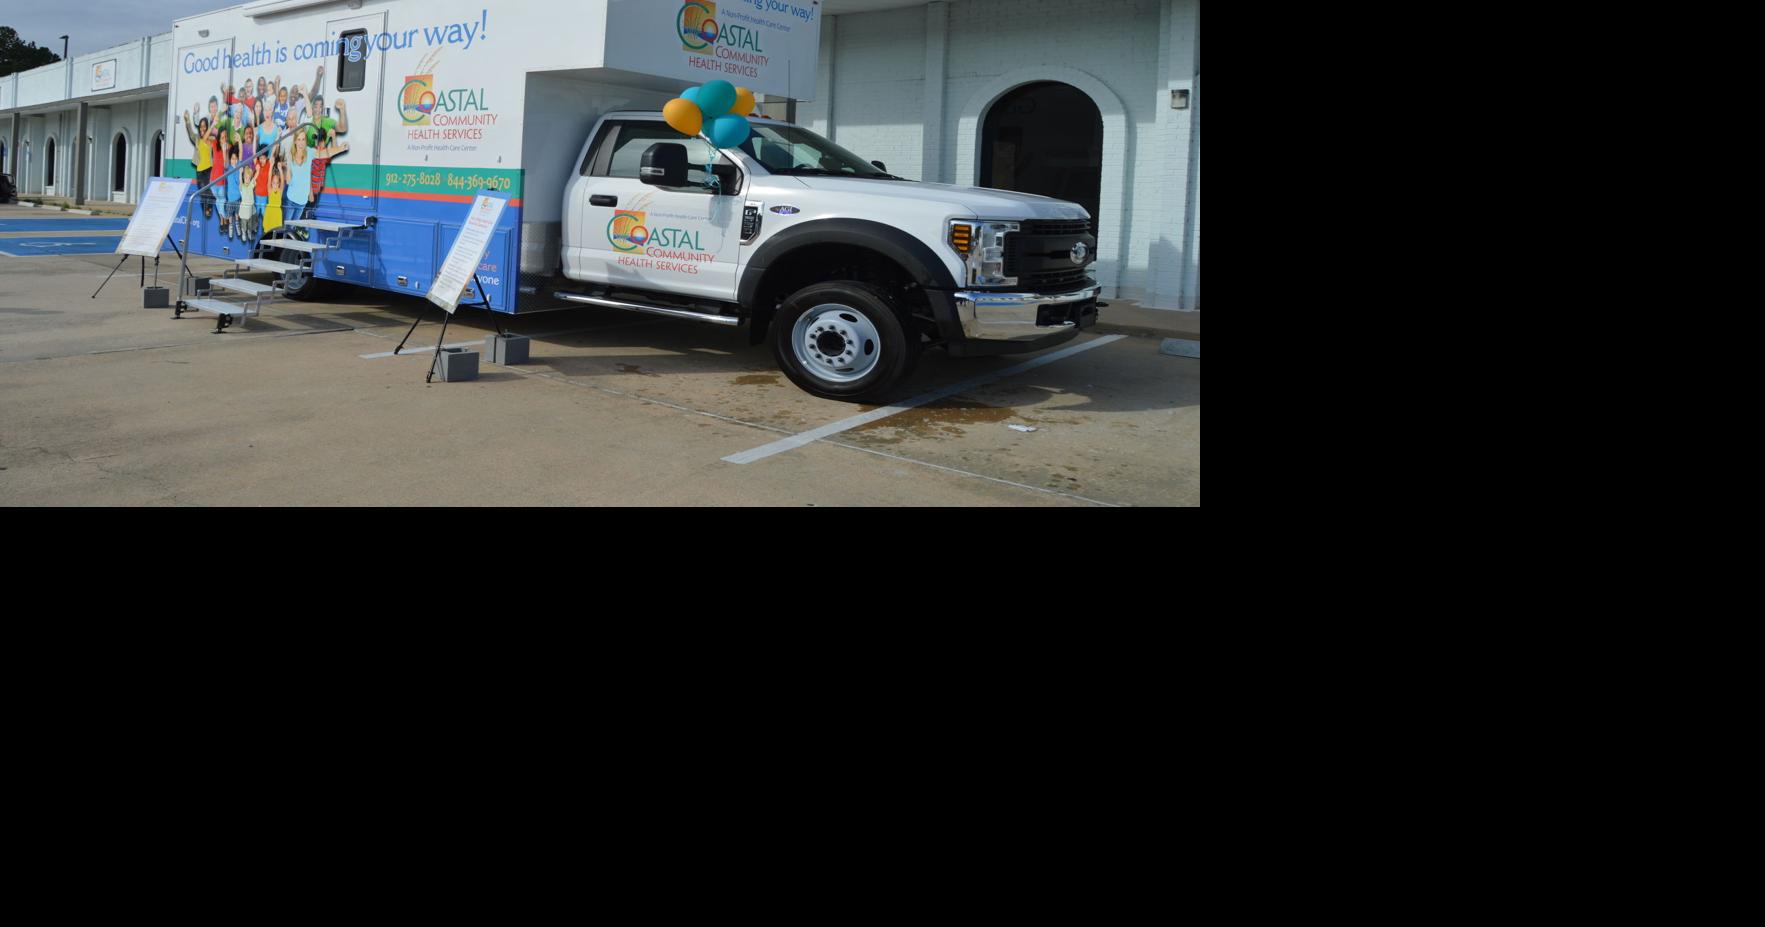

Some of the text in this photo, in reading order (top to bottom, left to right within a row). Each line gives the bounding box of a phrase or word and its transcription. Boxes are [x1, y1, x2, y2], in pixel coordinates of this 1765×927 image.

[766, 0, 788, 13] your
[791, 5, 814, 22] way!
[677, 2, 762, 52] COASTAL
[184, 9, 488, 74] Good health is coming your way!
[688, 56, 758, 78] HEALTH SERVICES
[716, 46, 769, 67] COMMUNITY
[398, 80, 488, 123] COASTAL
[432, 114, 498, 126] COMMUNITY
[408, 128, 482, 140] HEALTH SERVICES
[607, 214, 705, 251] COASTAL
[618, 256, 698, 274] HEALTH SERVICES
[646, 246, 715, 263] COMMUNITY
